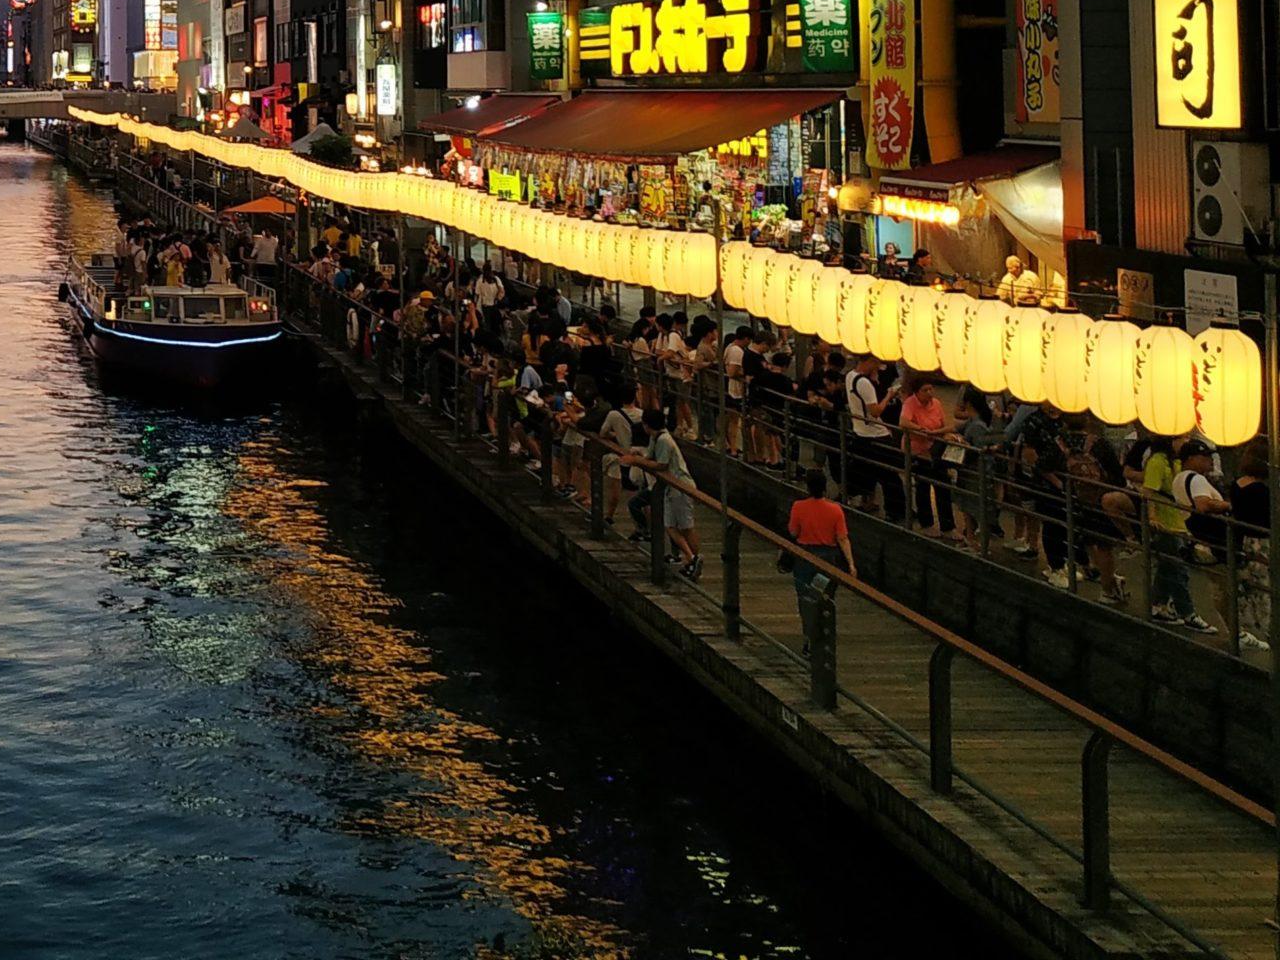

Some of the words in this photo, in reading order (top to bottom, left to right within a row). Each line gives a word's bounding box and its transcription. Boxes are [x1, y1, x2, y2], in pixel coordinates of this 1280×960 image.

[531, 23, 562, 50] 薬
[805, 29, 849, 37] Medicine
[830, 38, 850, 57] 약
